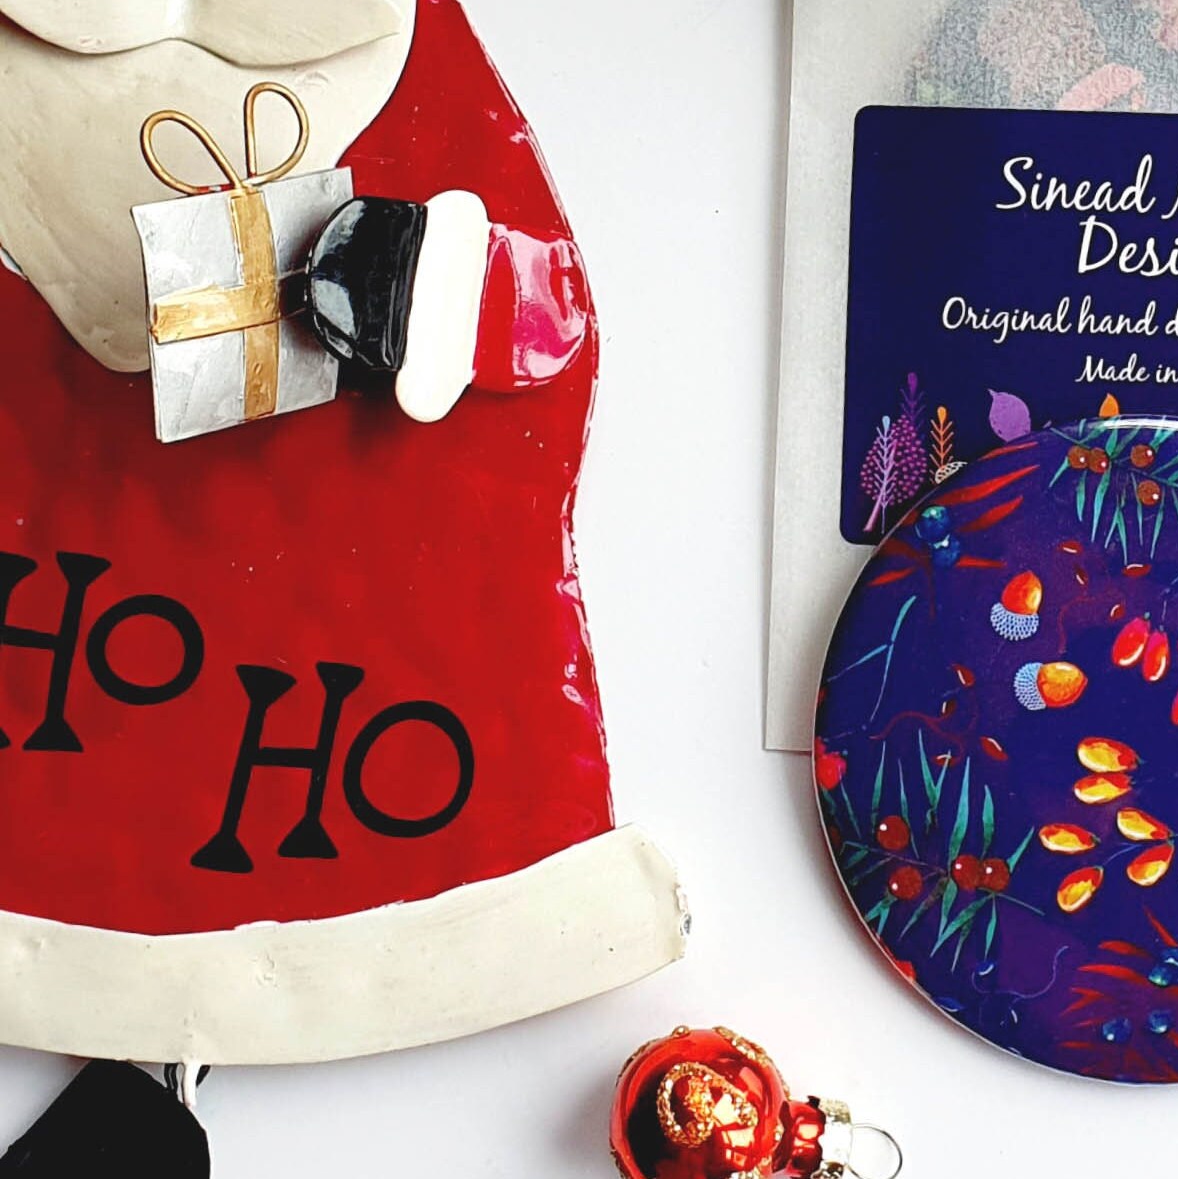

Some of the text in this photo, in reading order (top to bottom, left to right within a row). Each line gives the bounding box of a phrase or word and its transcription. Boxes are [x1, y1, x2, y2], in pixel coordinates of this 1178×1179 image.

[995, 153, 1156, 214] Sinead
[941, 295, 1073, 344] Original
[1077, 295, 1159, 336] hand
[1075, 352, 1150, 383] Made
[190, 661, 475, 874] HO
